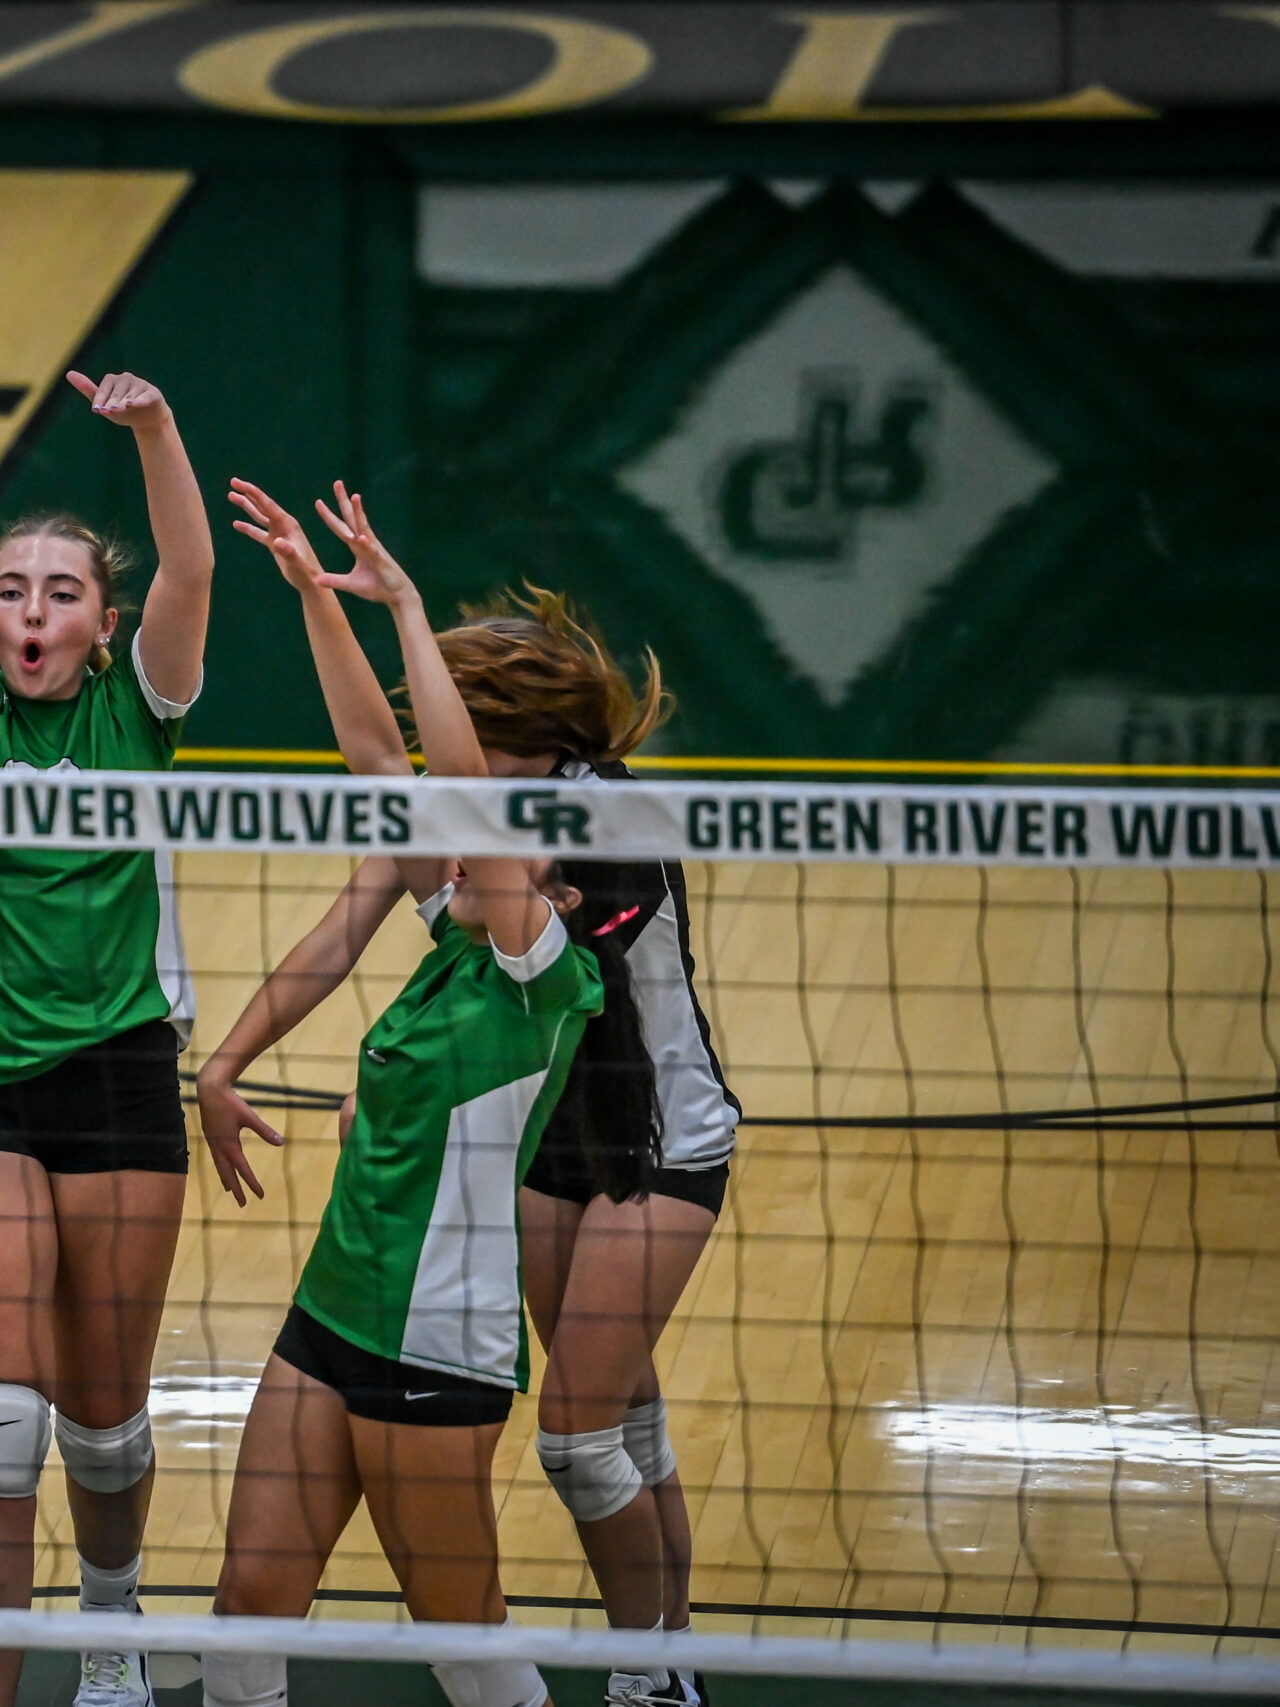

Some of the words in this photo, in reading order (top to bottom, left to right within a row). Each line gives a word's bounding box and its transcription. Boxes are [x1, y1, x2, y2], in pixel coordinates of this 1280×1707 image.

[157, 786, 412, 846] WOLVES
[684, 795, 883, 856] GREEN
[902, 798, 1091, 860] RIVER
